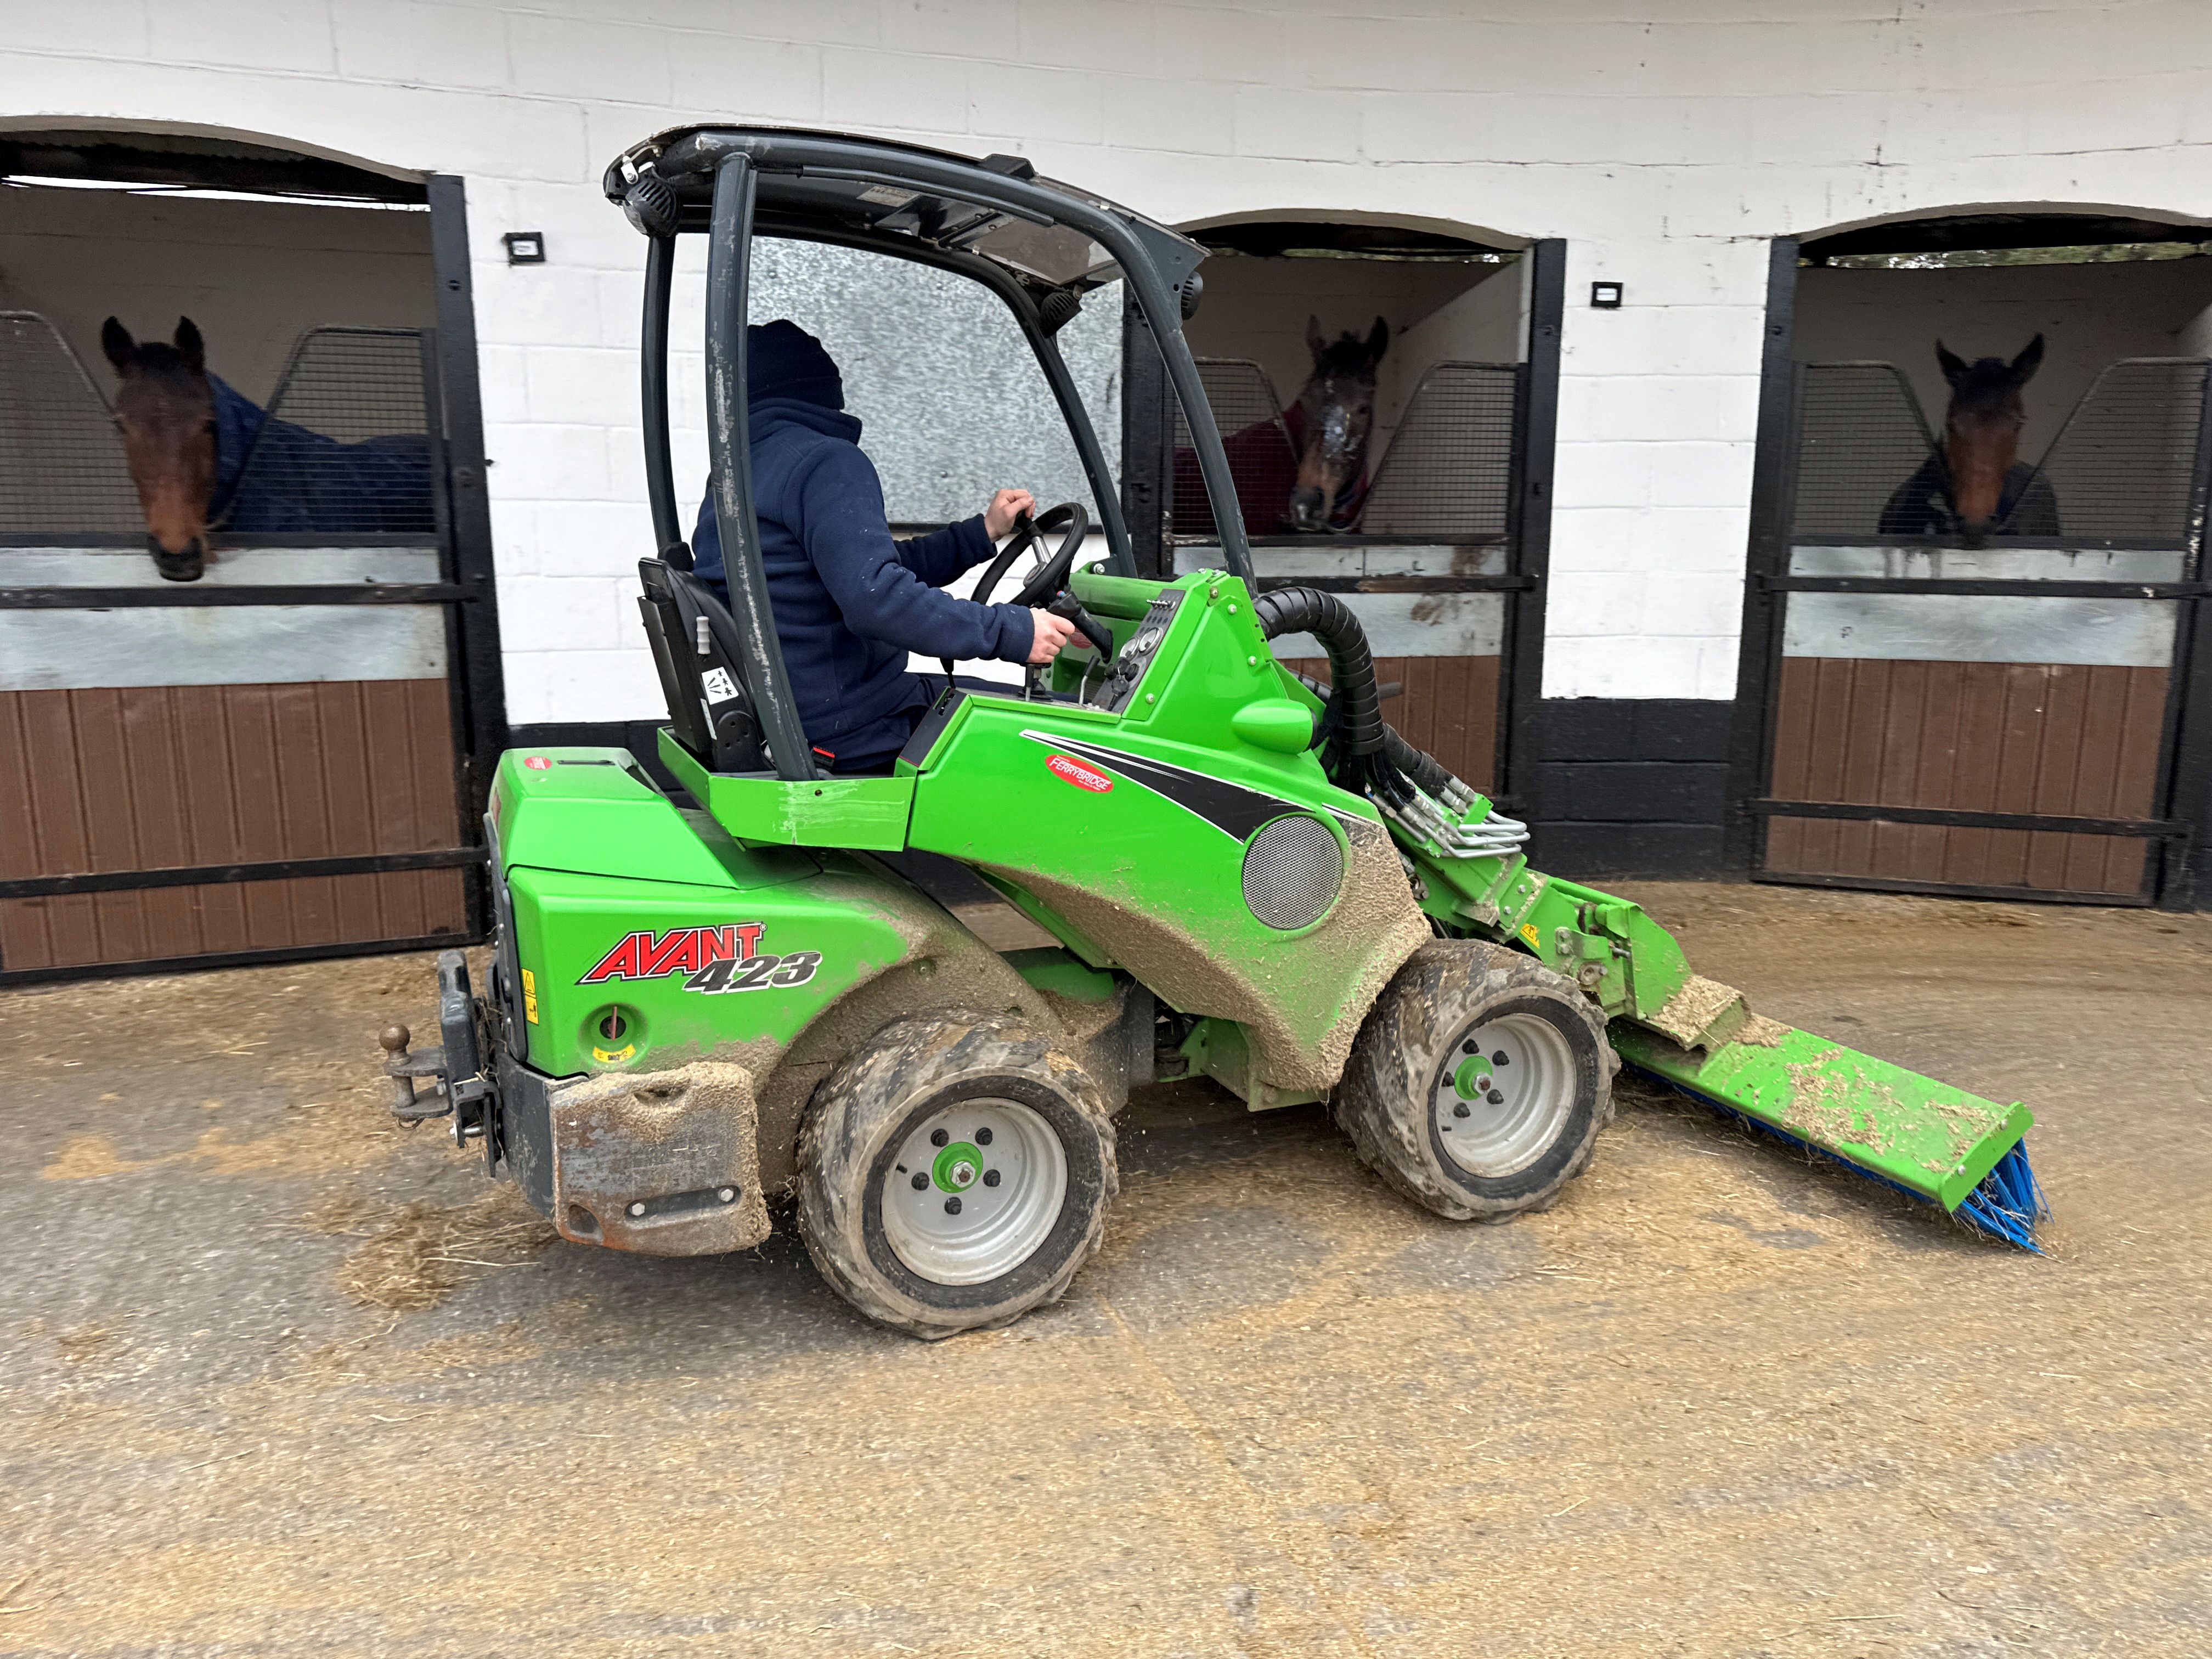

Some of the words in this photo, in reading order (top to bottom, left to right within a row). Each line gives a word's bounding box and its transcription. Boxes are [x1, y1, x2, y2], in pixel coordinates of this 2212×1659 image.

[1049, 758, 1111, 790] FERRYBRIDGE
[574, 922, 764, 985] AVANT
[682, 951, 823, 995] 423
